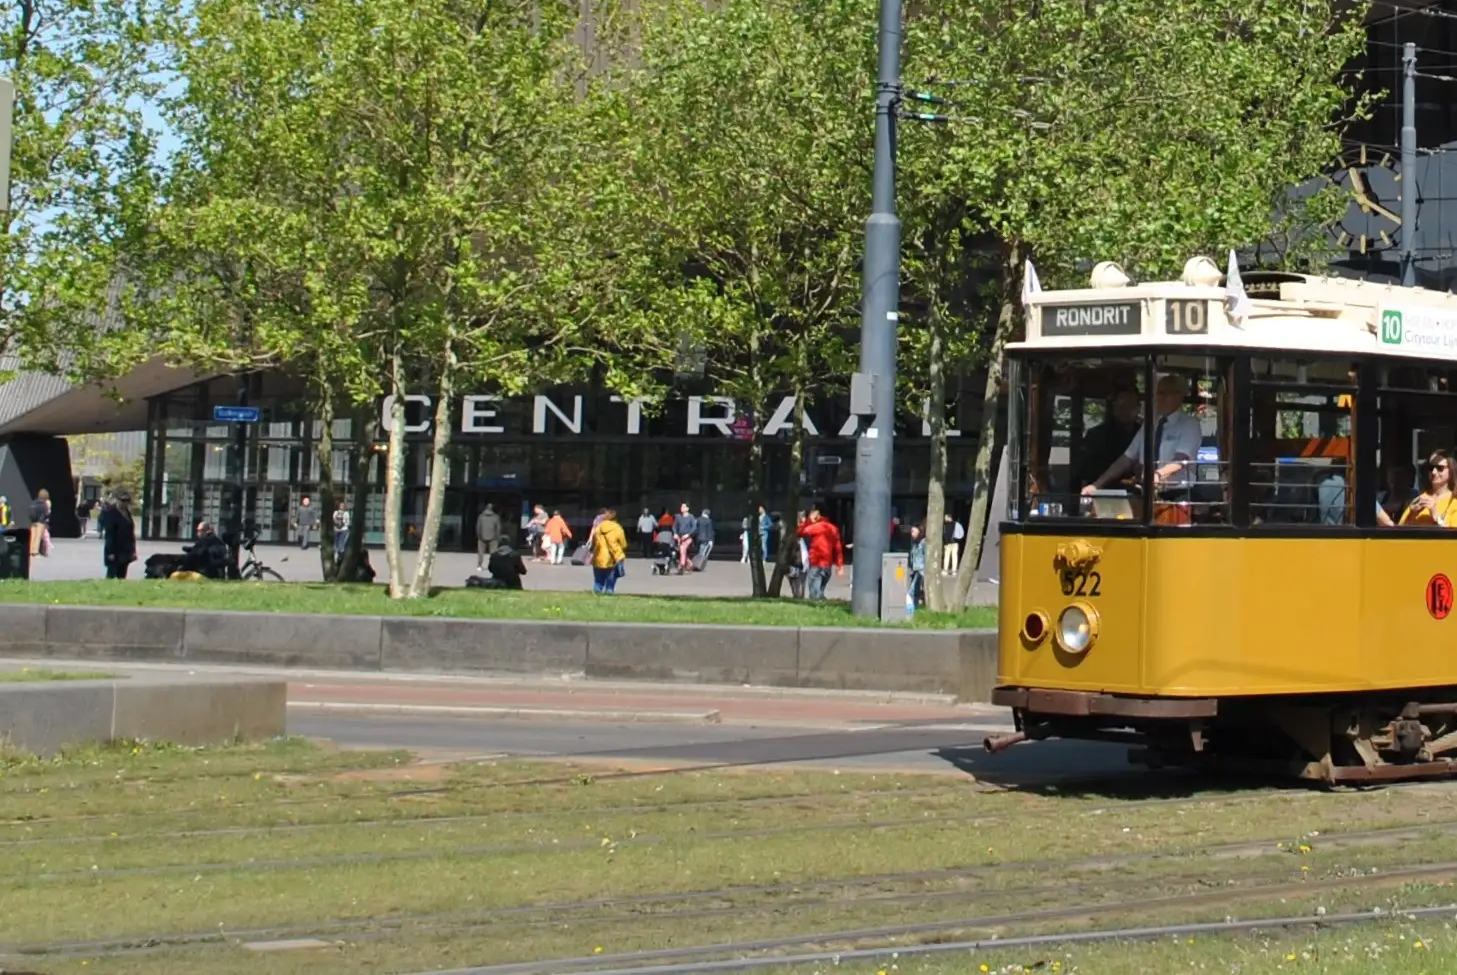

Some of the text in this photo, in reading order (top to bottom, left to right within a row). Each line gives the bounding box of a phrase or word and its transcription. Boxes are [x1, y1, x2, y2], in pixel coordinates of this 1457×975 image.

[1056, 306, 1131, 327] RONDRIT
[1171, 301, 1204, 332] 10
[1383, 315, 1400, 340] 10
[382, 394, 960, 437] CENTRAL
[1063, 571, 1101, 596] 522
